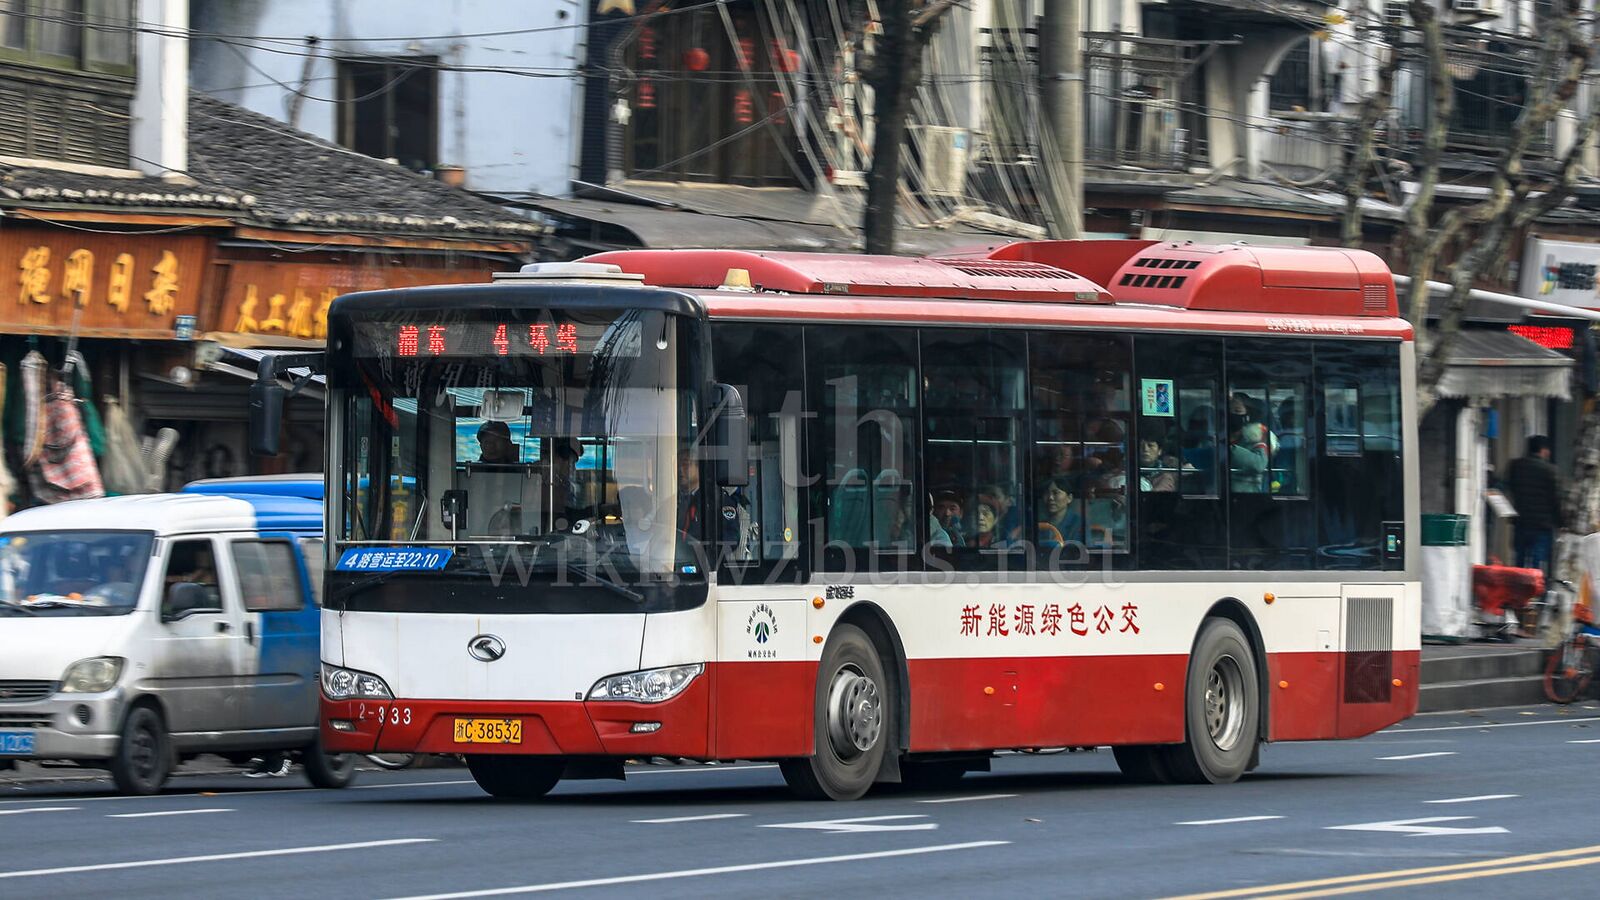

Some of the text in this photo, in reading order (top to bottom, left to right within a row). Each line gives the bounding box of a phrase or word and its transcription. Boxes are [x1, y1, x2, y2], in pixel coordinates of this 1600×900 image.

[493, 324, 509, 355] 4
[529, 324, 577, 355] 环线
[960, 602, 1140, 637] 新能源绿色公交
[359, 702, 411, 725] 2-333
